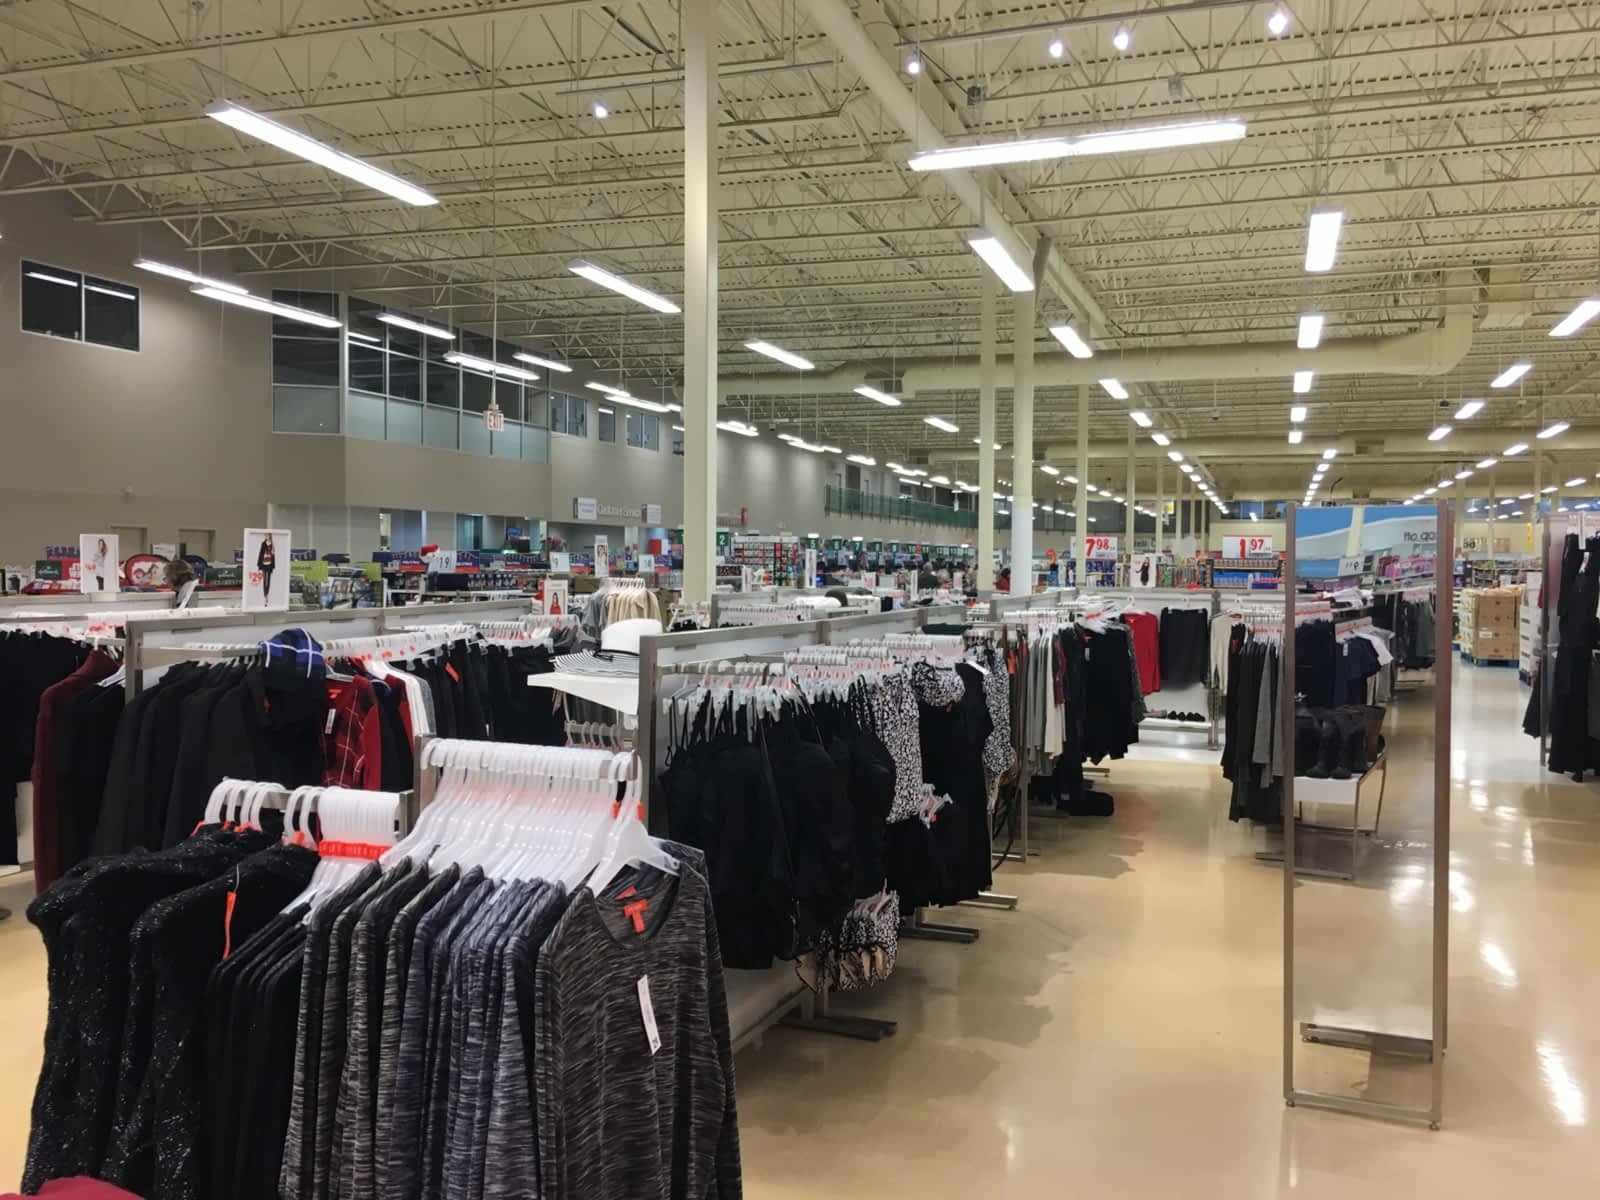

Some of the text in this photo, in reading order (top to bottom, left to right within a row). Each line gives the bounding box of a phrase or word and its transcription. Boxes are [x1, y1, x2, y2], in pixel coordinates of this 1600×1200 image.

[488, 414, 503, 430] EXIT
[719, 534, 726, 546] 2
[922, 545, 929, 553] 11
[1239, 538, 1264, 558] 1 97
[439, 557, 450, 569] 19
